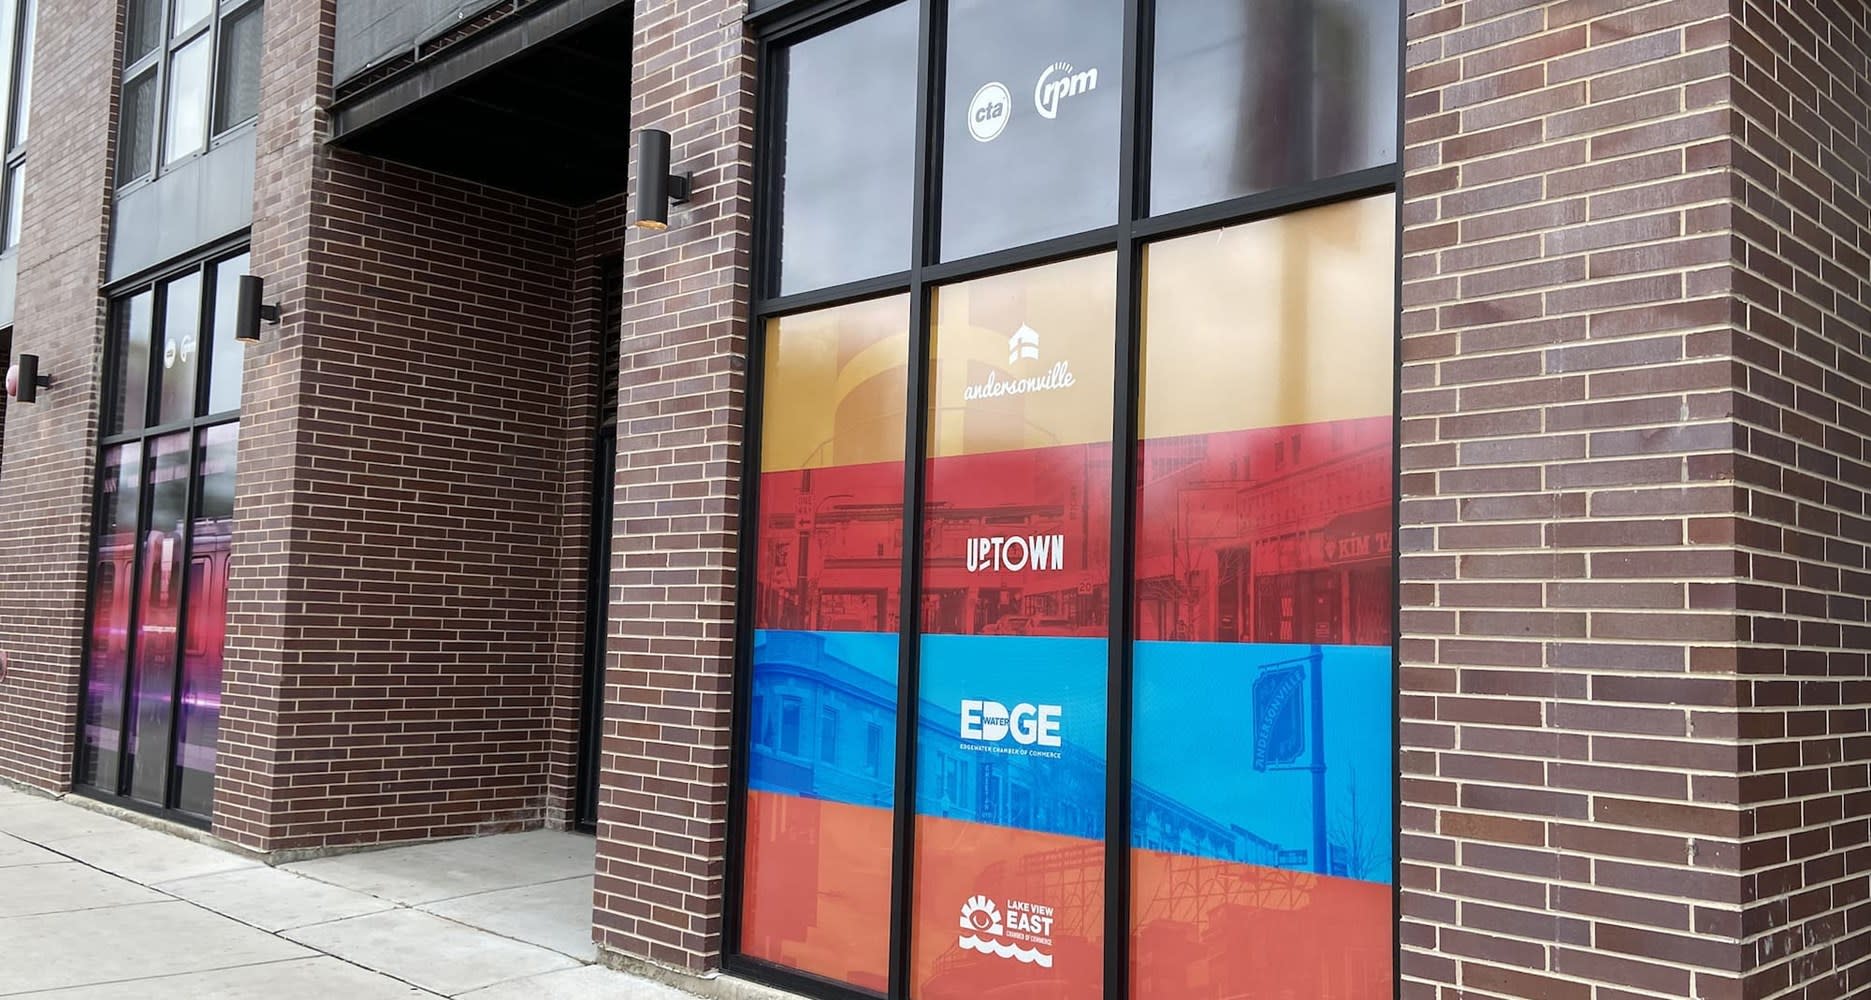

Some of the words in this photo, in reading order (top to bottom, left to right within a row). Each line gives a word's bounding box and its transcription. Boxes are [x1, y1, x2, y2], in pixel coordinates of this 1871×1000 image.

[1035, 62, 1098, 119] rpm
[975, 102, 1004, 123] cta
[964, 360, 1076, 400] andersonville
[967, 535, 1063, 572] UPTOWN
[961, 700, 1062, 747] EDGE
[983, 716, 1009, 727] WATER
[960, 743, 991, 752] EDGEWATER
[992, 746, 1019, 756] CHAMBER
[1029, 750, 1061, 759] COMMERCE
[1008, 899, 1029, 912] LAKE
[1031, 904, 1053, 916] VIEW
[1007, 911, 1053, 936] EAST
